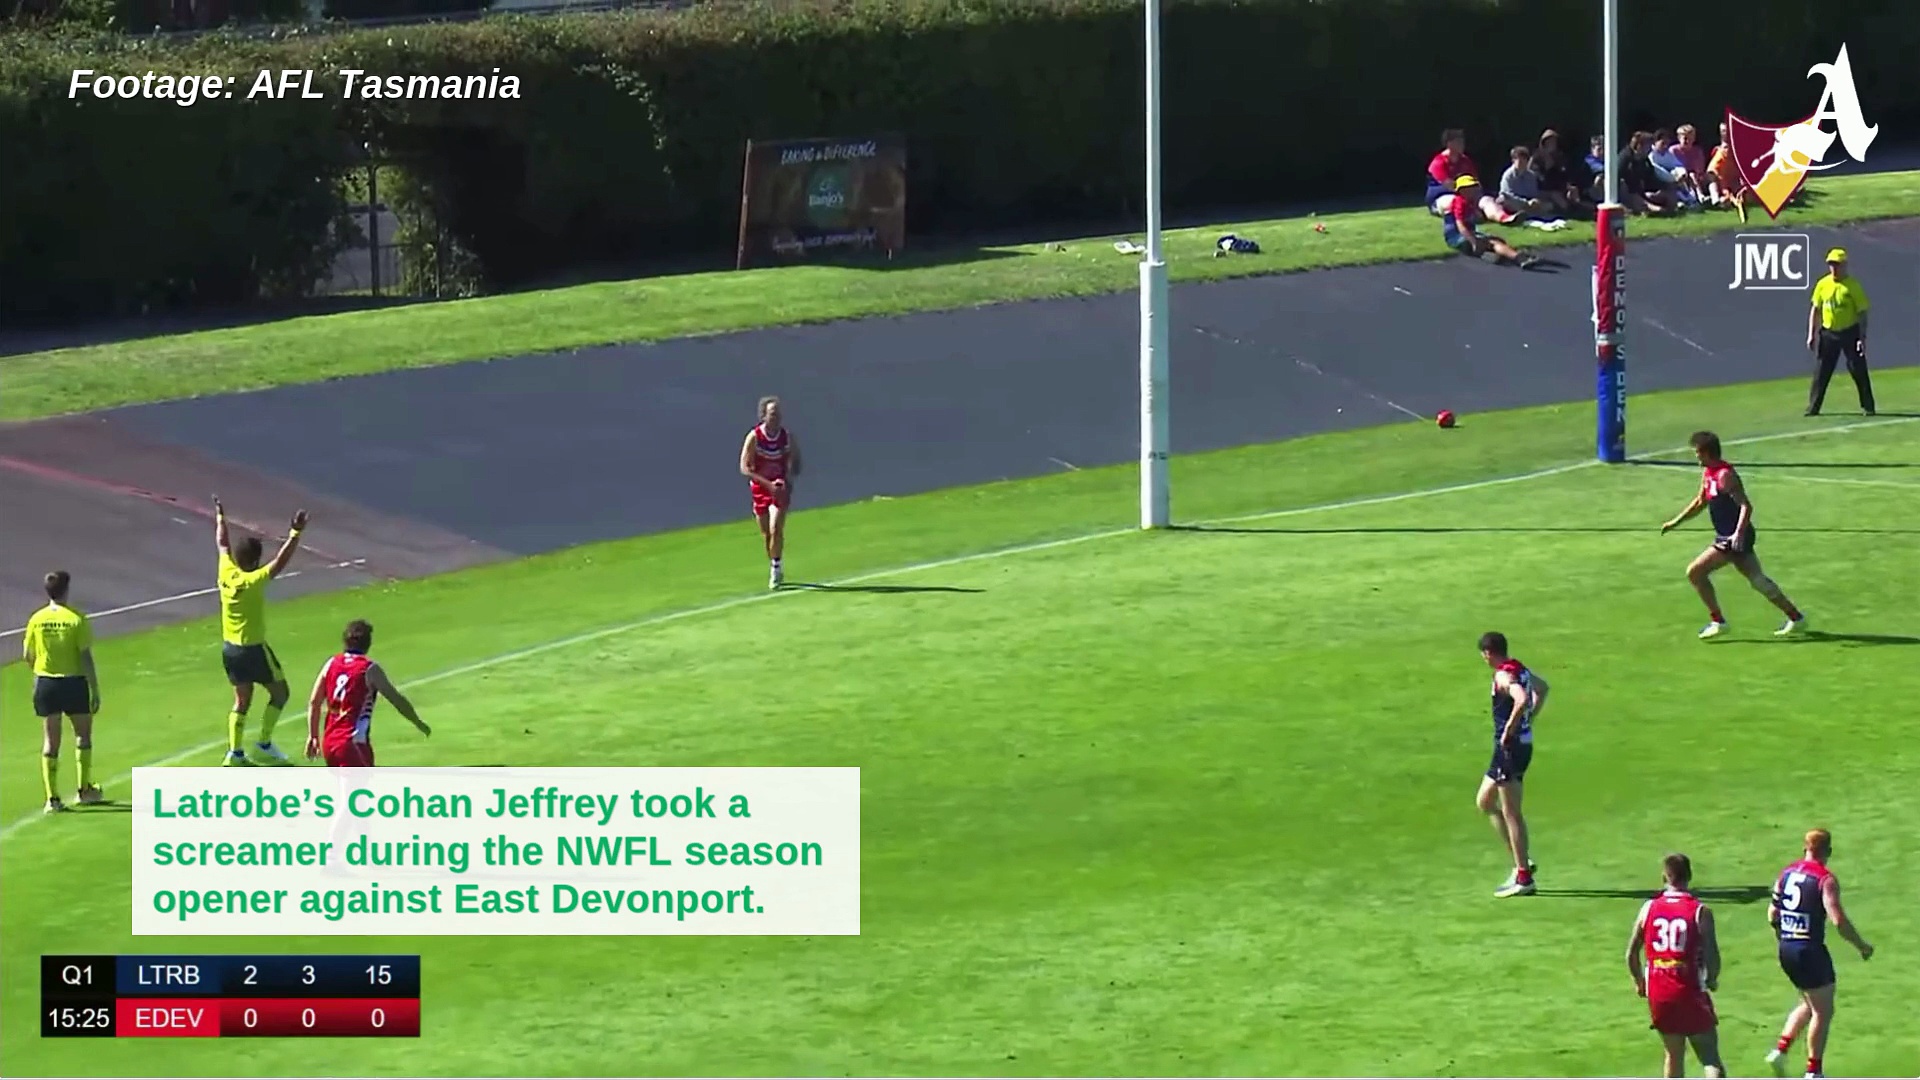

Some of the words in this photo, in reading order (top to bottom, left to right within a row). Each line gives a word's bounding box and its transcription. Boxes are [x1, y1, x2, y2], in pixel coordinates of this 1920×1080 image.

[332, 674, 349, 701] 8
[1782, 872, 1806, 910] 5
[1652, 917, 1687, 952] 30
